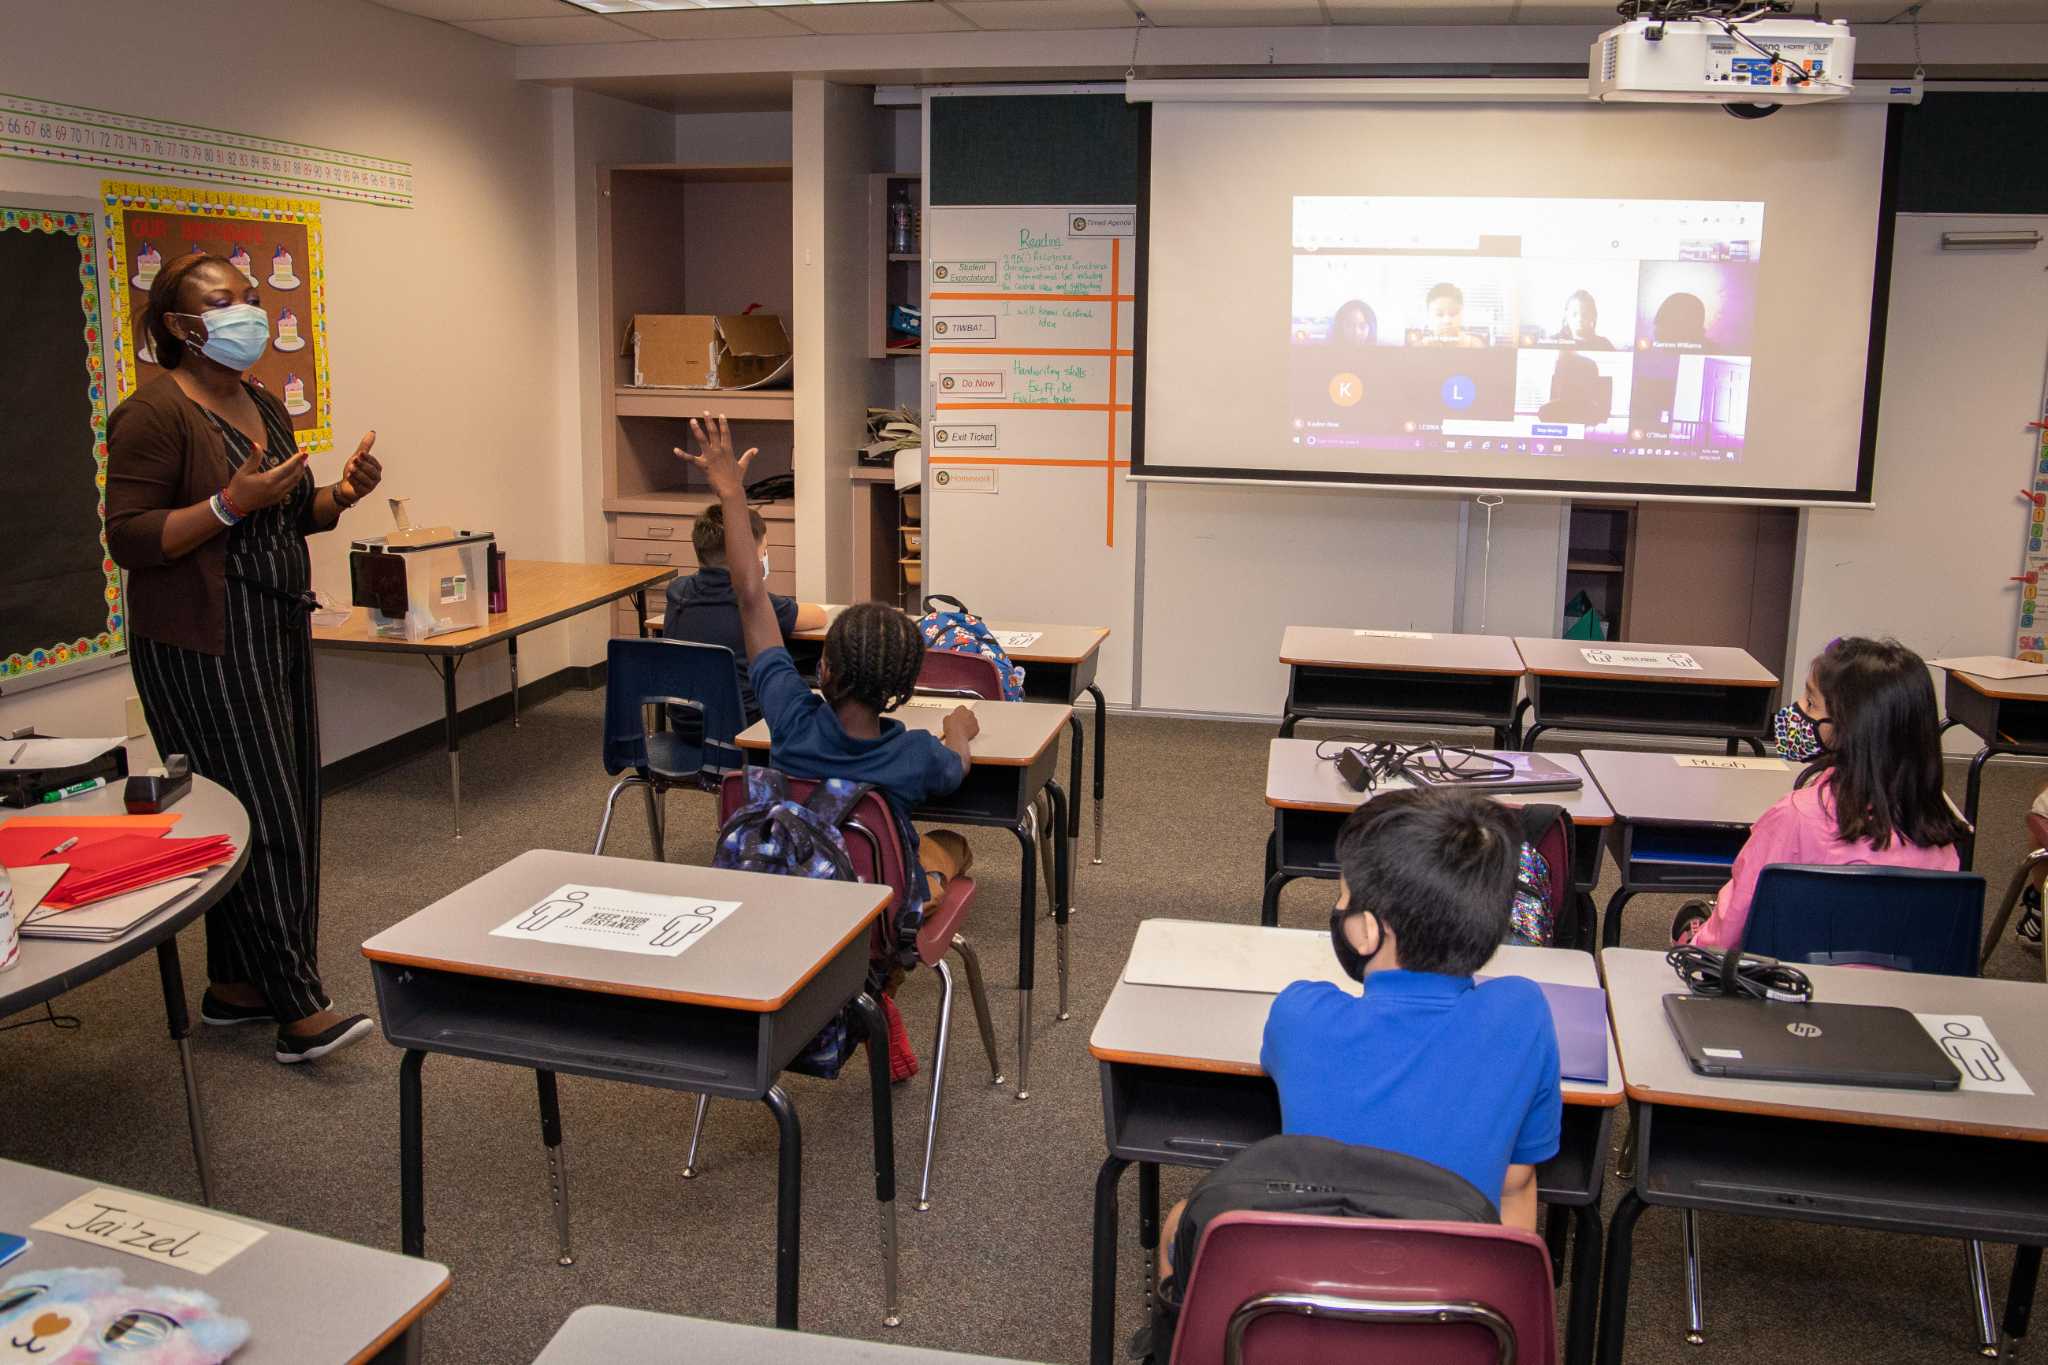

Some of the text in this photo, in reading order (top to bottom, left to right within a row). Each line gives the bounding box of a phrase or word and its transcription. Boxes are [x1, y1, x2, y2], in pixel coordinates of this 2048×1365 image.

[8, 118, 20, 133] 66
[24, 120, 36, 136] 67
[40, 123, 51, 139] 68
[56, 125, 67, 141] 69
[70, 127, 81, 144] 70
[85, 129, 95, 145] 71
[100, 131, 110, 148] 72
[113, 134, 124, 150] 73
[127, 136, 137, 153] 74
[961, 379, 996, 388] Do Now
[1340, 383, 1351, 397] K
[1453, 384, 1464, 400] L
[952, 432, 993, 442] Exit Ticket
[582, 918, 640, 930] DISTANCE
[591, 912, 650, 924] KEEP YOUR
